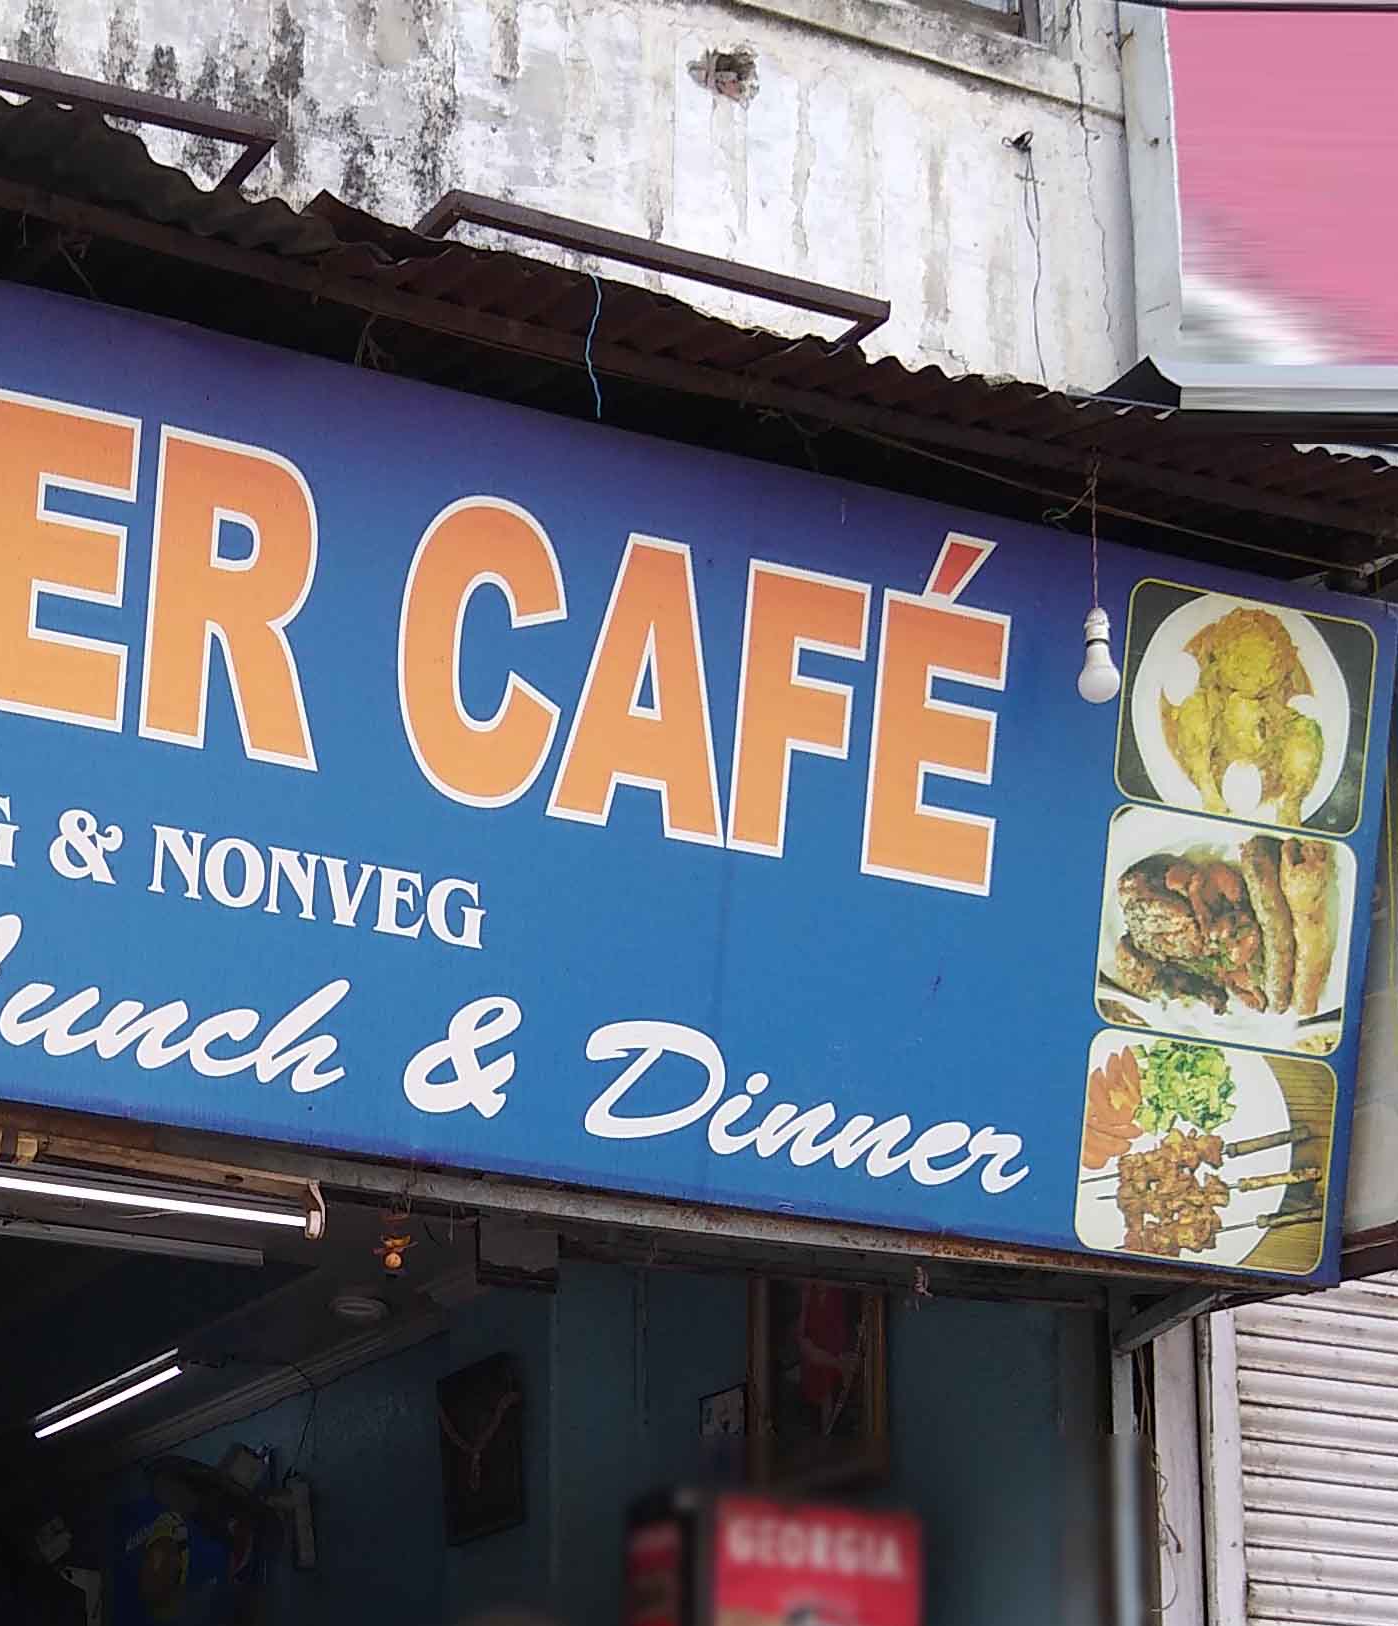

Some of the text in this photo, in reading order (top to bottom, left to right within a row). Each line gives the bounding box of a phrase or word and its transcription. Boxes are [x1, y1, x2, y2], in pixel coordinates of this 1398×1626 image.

[397, 495, 1012, 897] CAFÉ
[48, 808, 124, 885] &
[147, 823, 487, 950] NONVEG
[402, 996, 523, 1120] &
[585, 1020, 1030, 1194] Dinner
